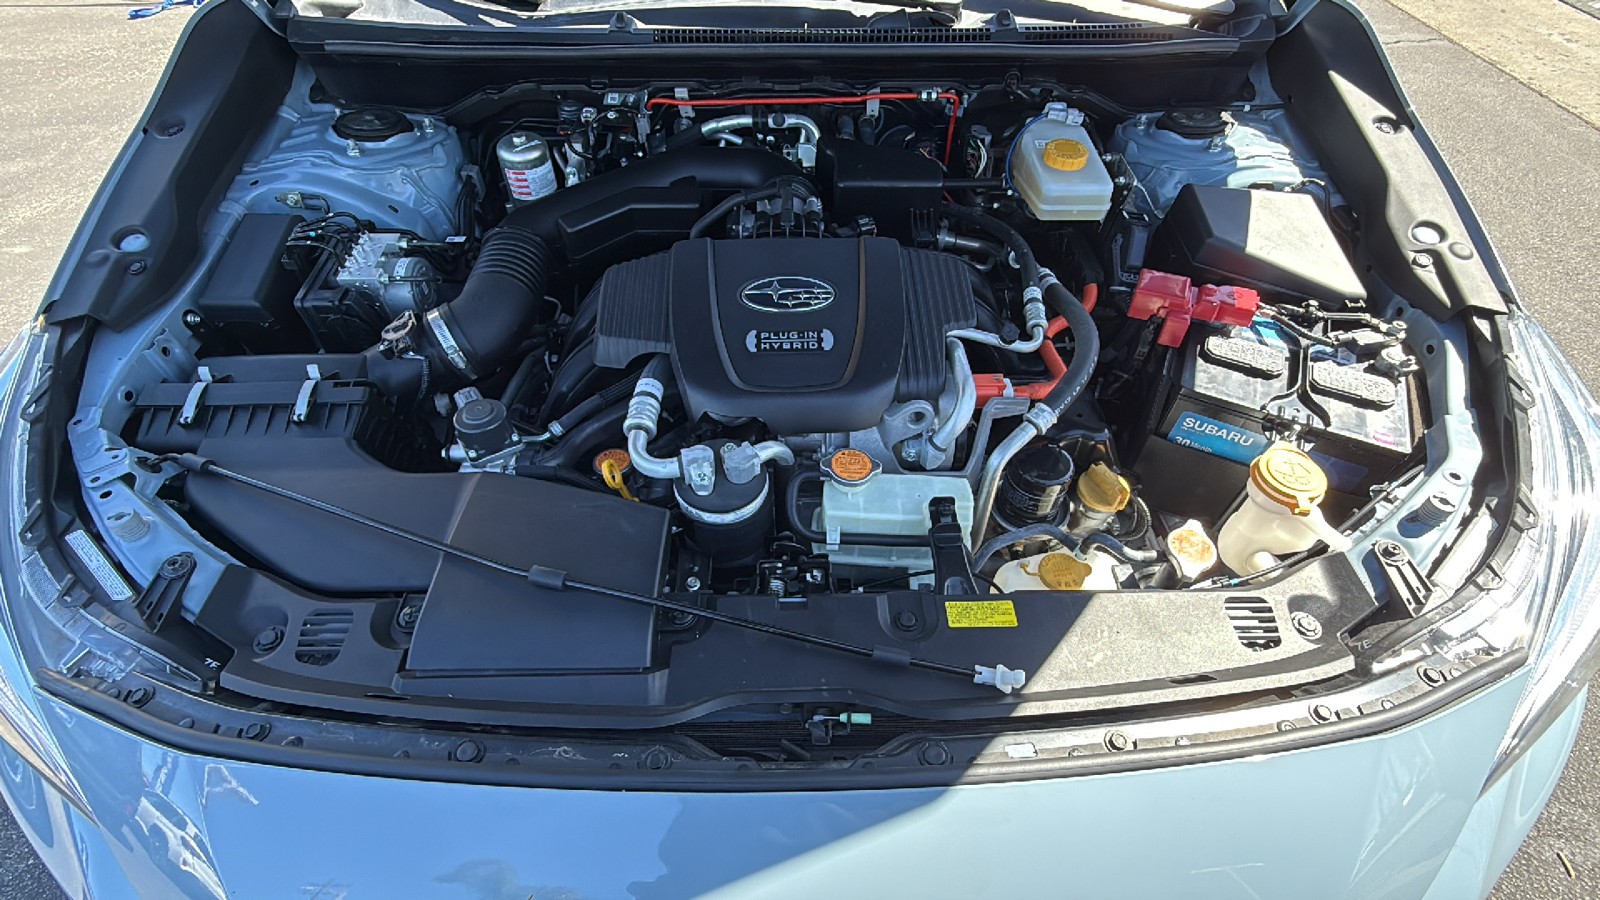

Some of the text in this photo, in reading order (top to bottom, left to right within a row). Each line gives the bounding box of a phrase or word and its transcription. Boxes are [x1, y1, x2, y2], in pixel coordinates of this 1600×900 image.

[760, 331, 818, 339] PLUG-IN
[760, 341, 818, 350] HYBRID
[1182, 417, 1254, 446] SUBARU
